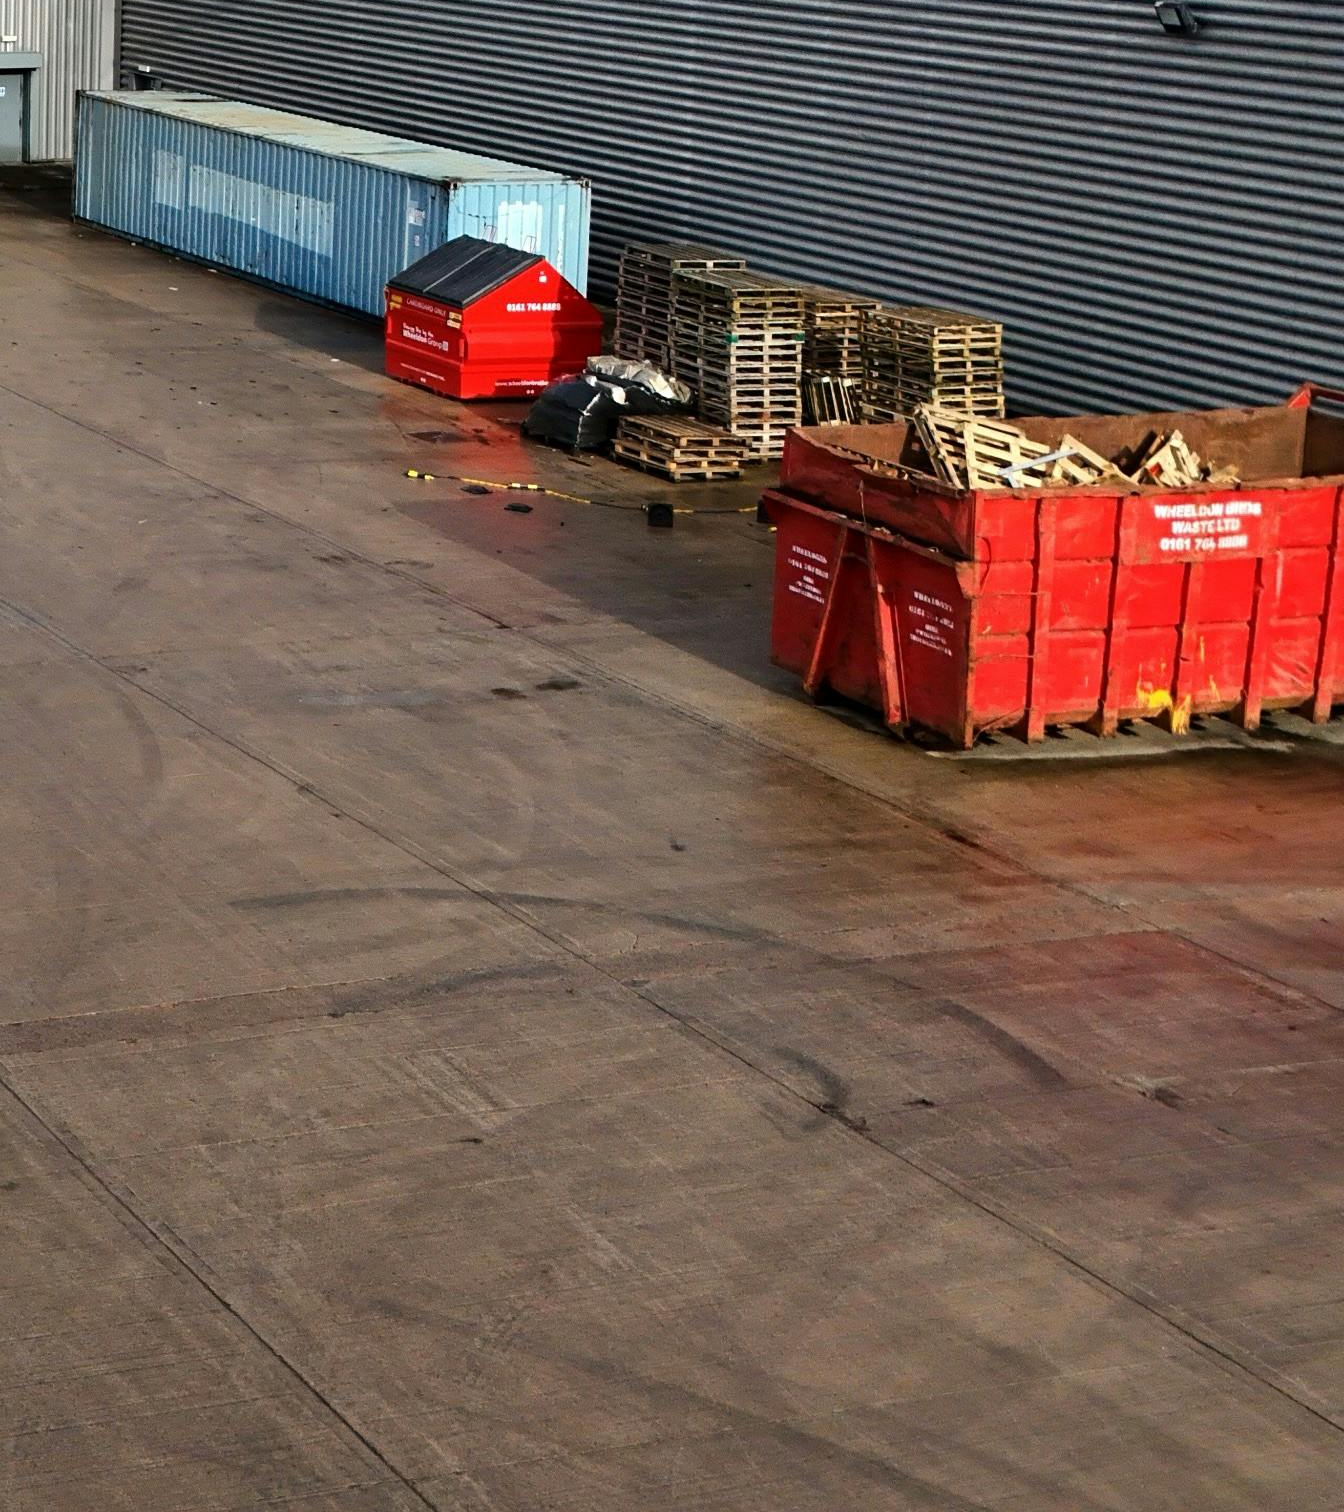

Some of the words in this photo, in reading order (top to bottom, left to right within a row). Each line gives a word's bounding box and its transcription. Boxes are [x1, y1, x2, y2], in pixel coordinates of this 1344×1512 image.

[506, 303, 525, 312] 0161
[527, 303, 541, 311] 764
[1172, 520, 1215, 535] WASTE
[1216, 517, 1241, 533] LTD
